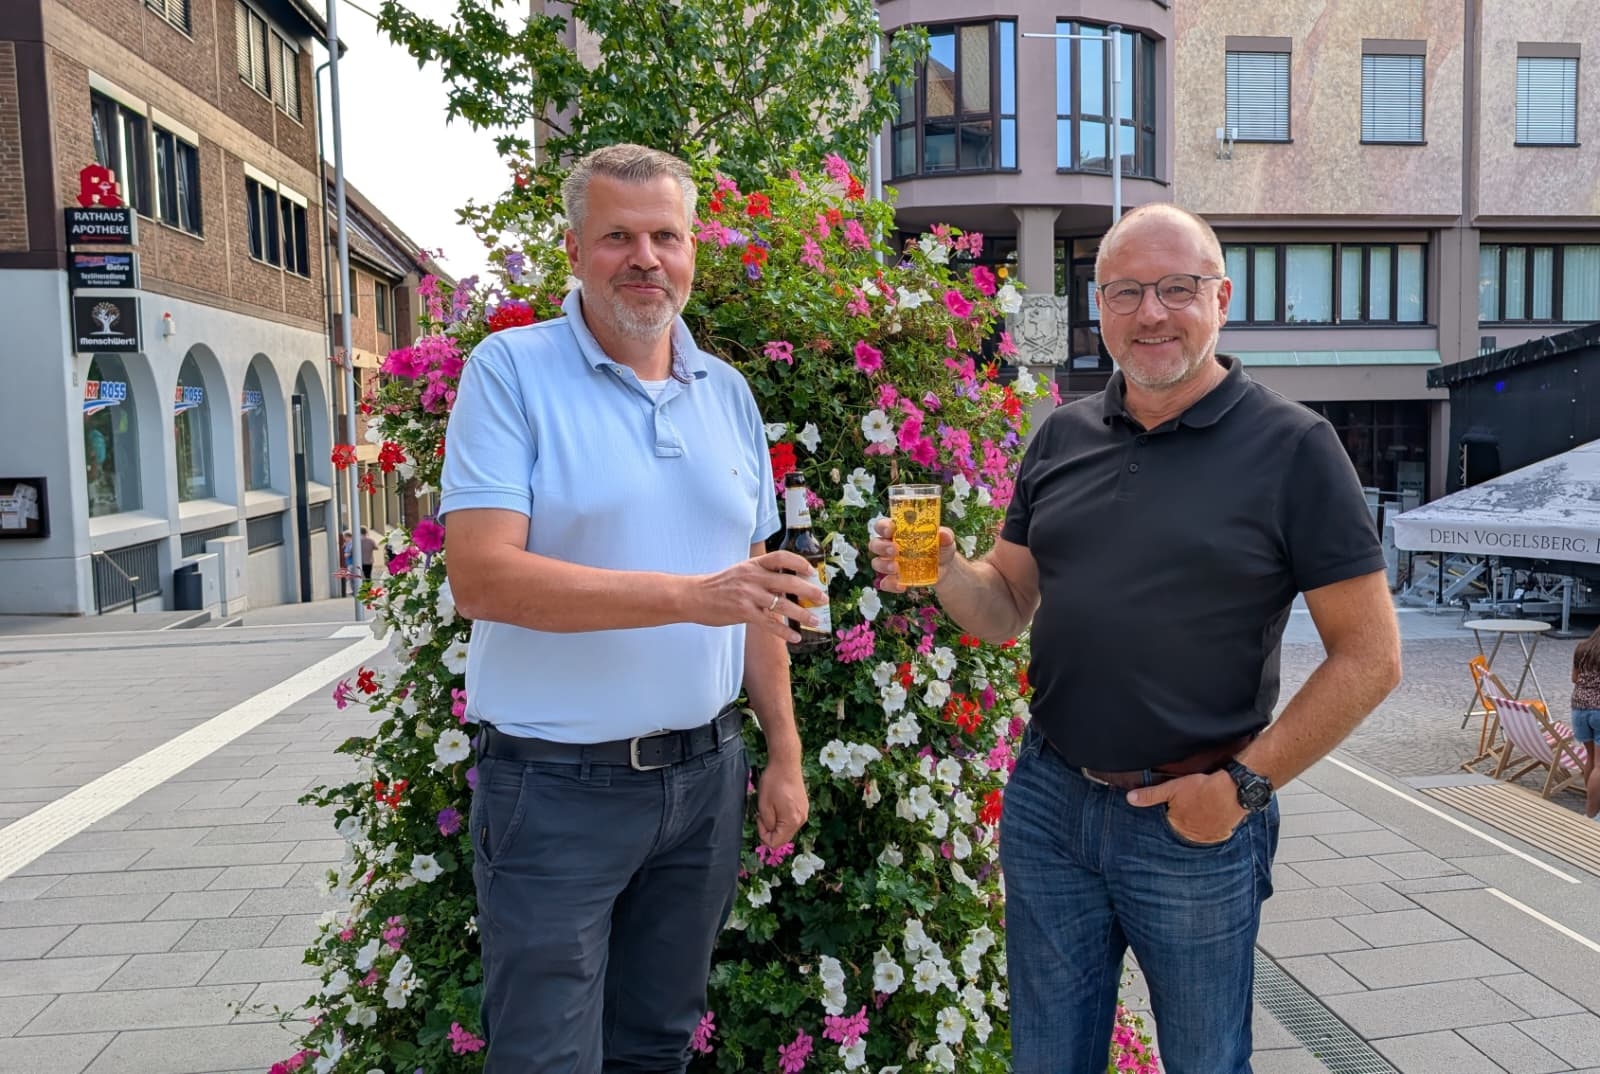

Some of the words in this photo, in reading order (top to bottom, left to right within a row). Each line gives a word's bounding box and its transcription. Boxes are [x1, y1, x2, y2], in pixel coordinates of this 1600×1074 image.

[74, 211, 125, 221] RATHAUS
[72, 225, 130, 234] APOTHEKE
[101, 381, 126, 400] ROSS
[1430, 528, 1469, 544] DEIN
[1474, 530, 1590, 553] VOGELSBERG.
